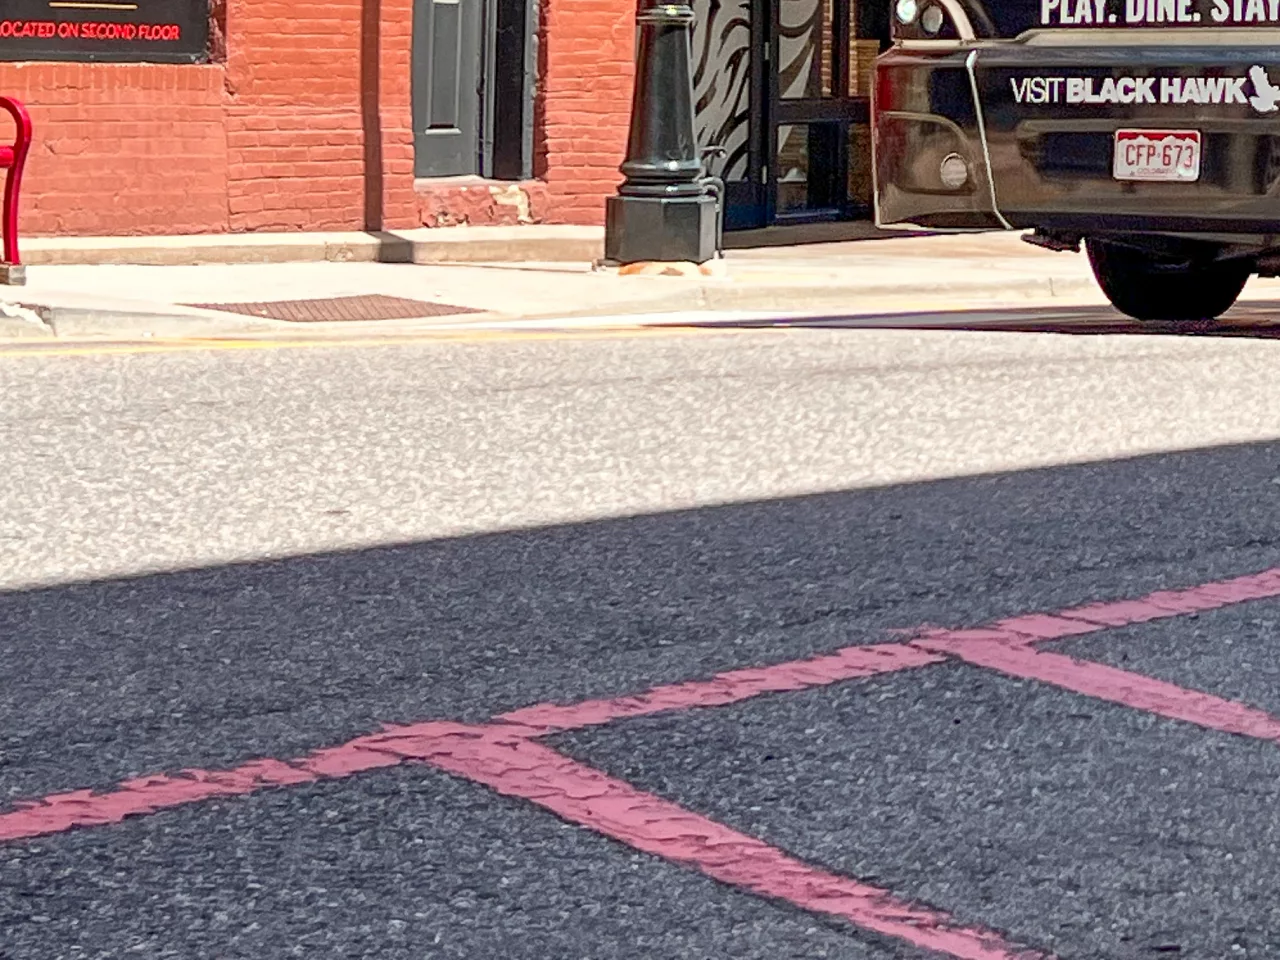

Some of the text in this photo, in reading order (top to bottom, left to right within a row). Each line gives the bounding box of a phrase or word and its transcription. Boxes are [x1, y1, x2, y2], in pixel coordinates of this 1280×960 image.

[0, 21, 179, 40] OCATED ON SECOND FLOOR
[1010, 76, 1249, 104] VISIT BLACK HAWK
